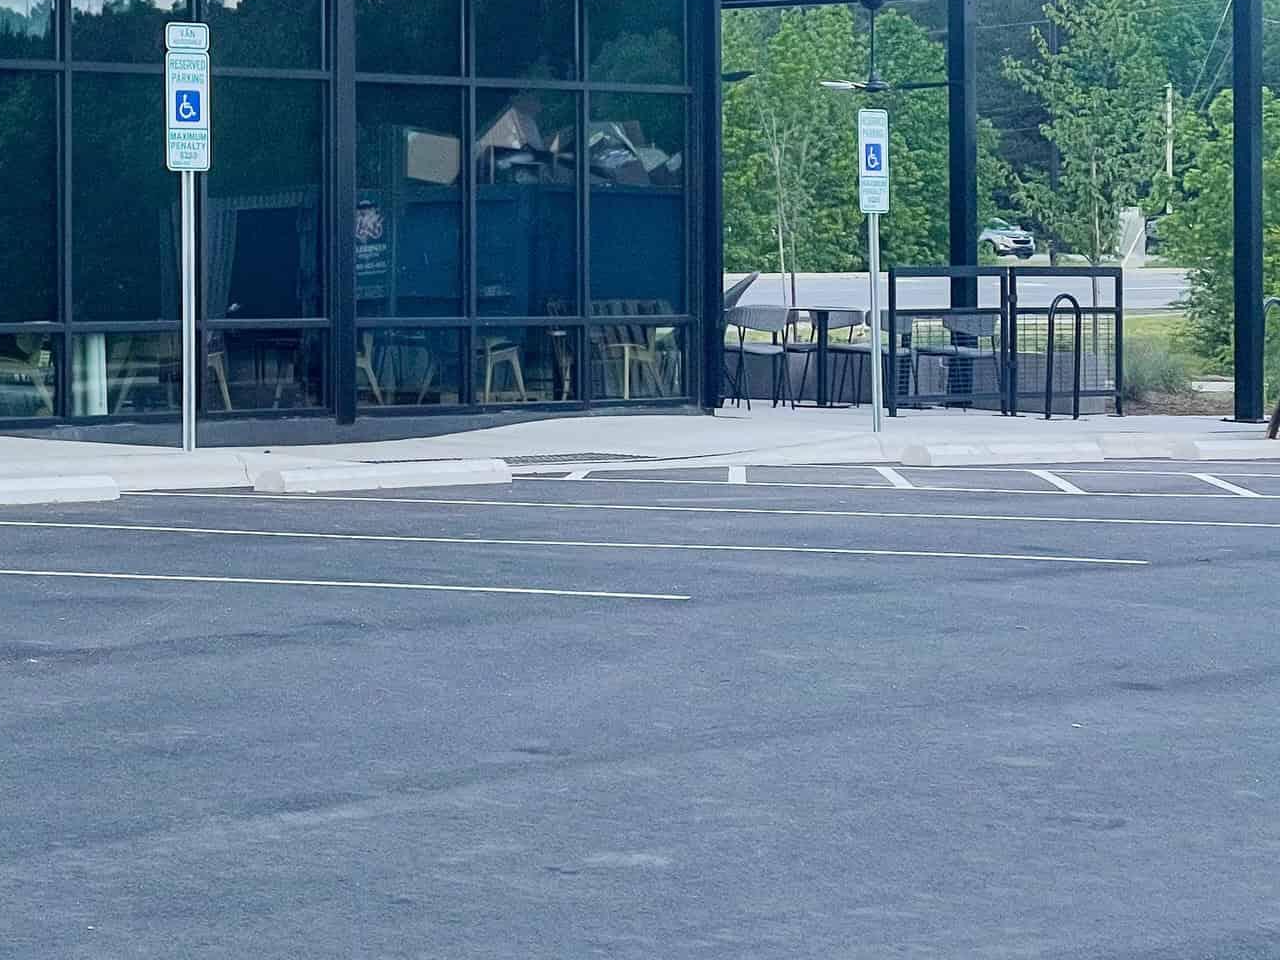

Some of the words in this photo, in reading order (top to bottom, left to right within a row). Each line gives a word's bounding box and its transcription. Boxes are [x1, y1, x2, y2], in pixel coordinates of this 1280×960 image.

[170, 58, 206, 71] RESERVED
[171, 72, 205, 84] PARKING
[169, 131, 207, 141] MAXIMUM
[170, 141, 206, 151] PENALTY
